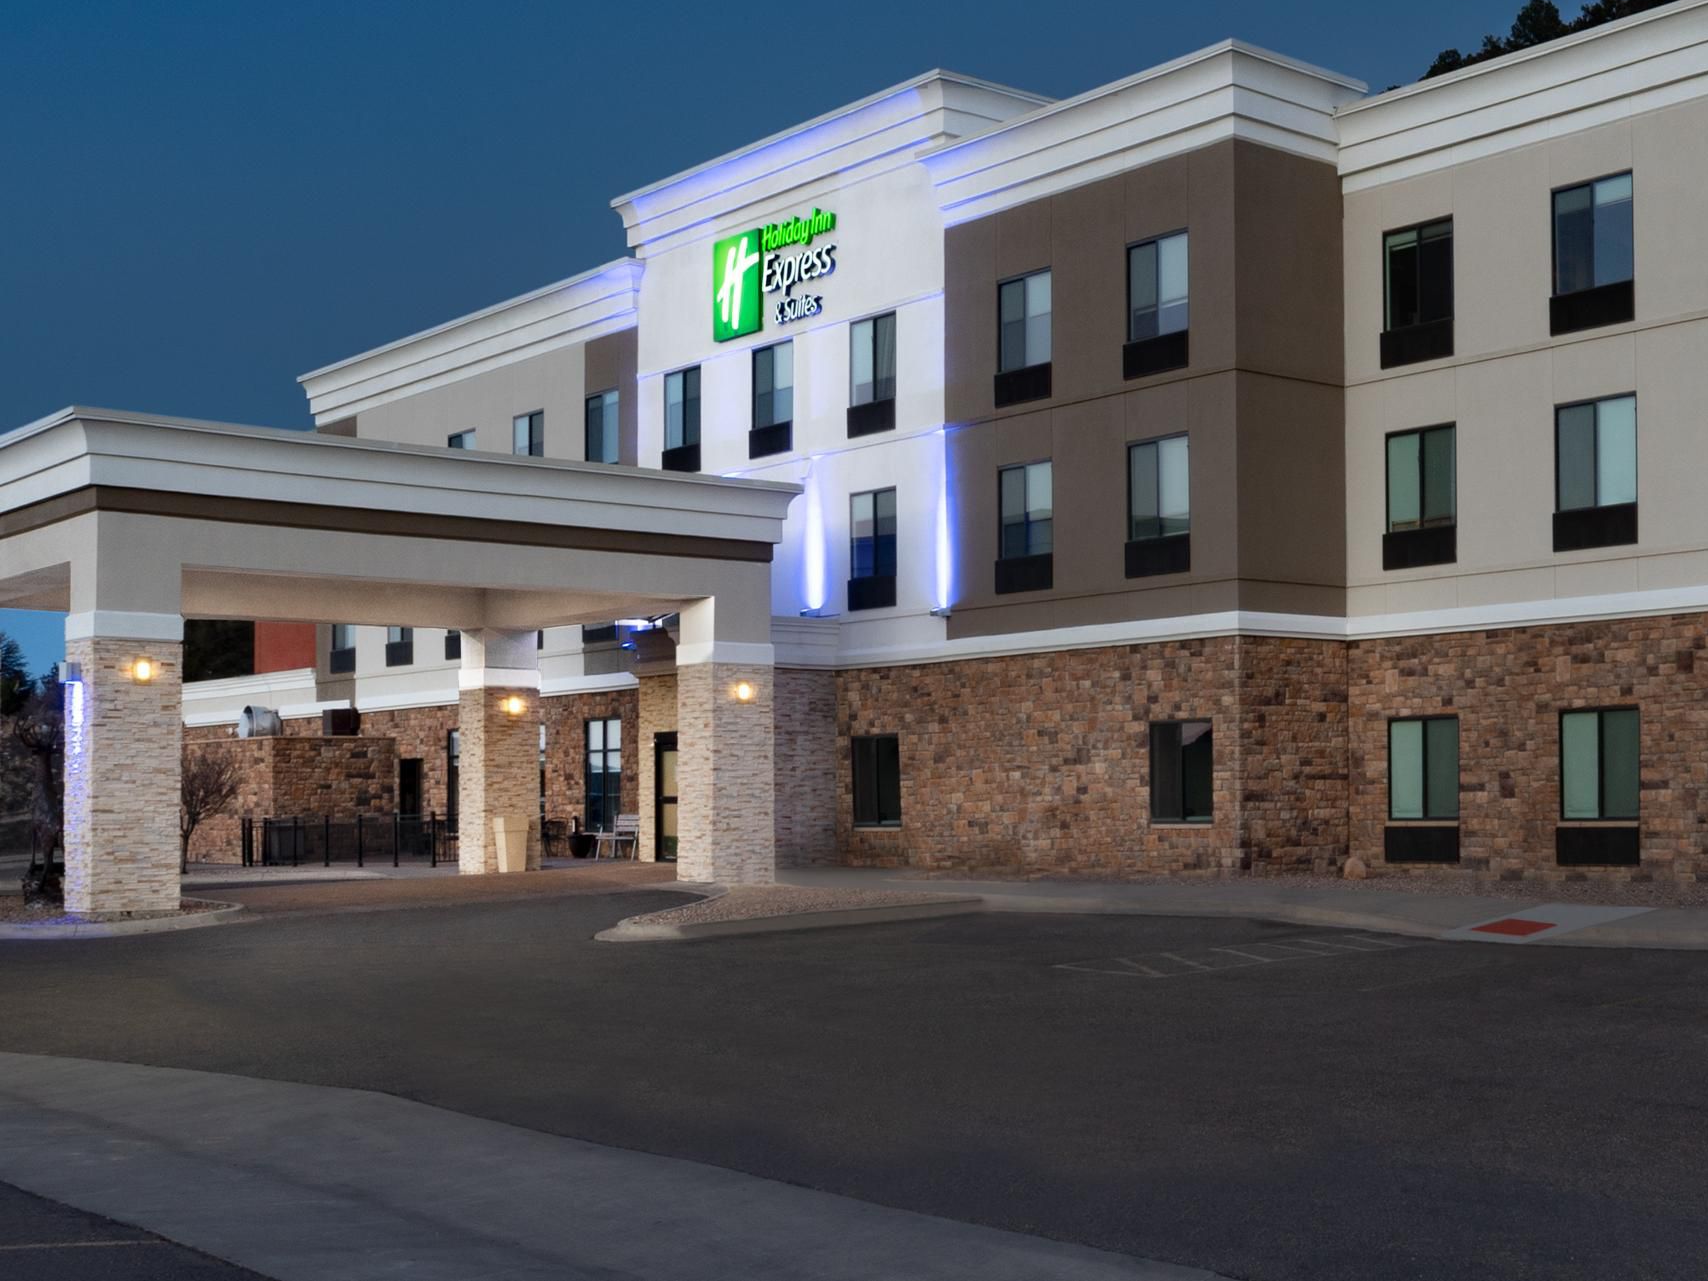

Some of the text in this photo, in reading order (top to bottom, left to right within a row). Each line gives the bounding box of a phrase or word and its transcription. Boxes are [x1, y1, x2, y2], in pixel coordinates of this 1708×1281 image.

[761, 208, 833, 251] Holiday Inn
[761, 244, 834, 295] Express
[775, 295, 820, 324] & Suites
